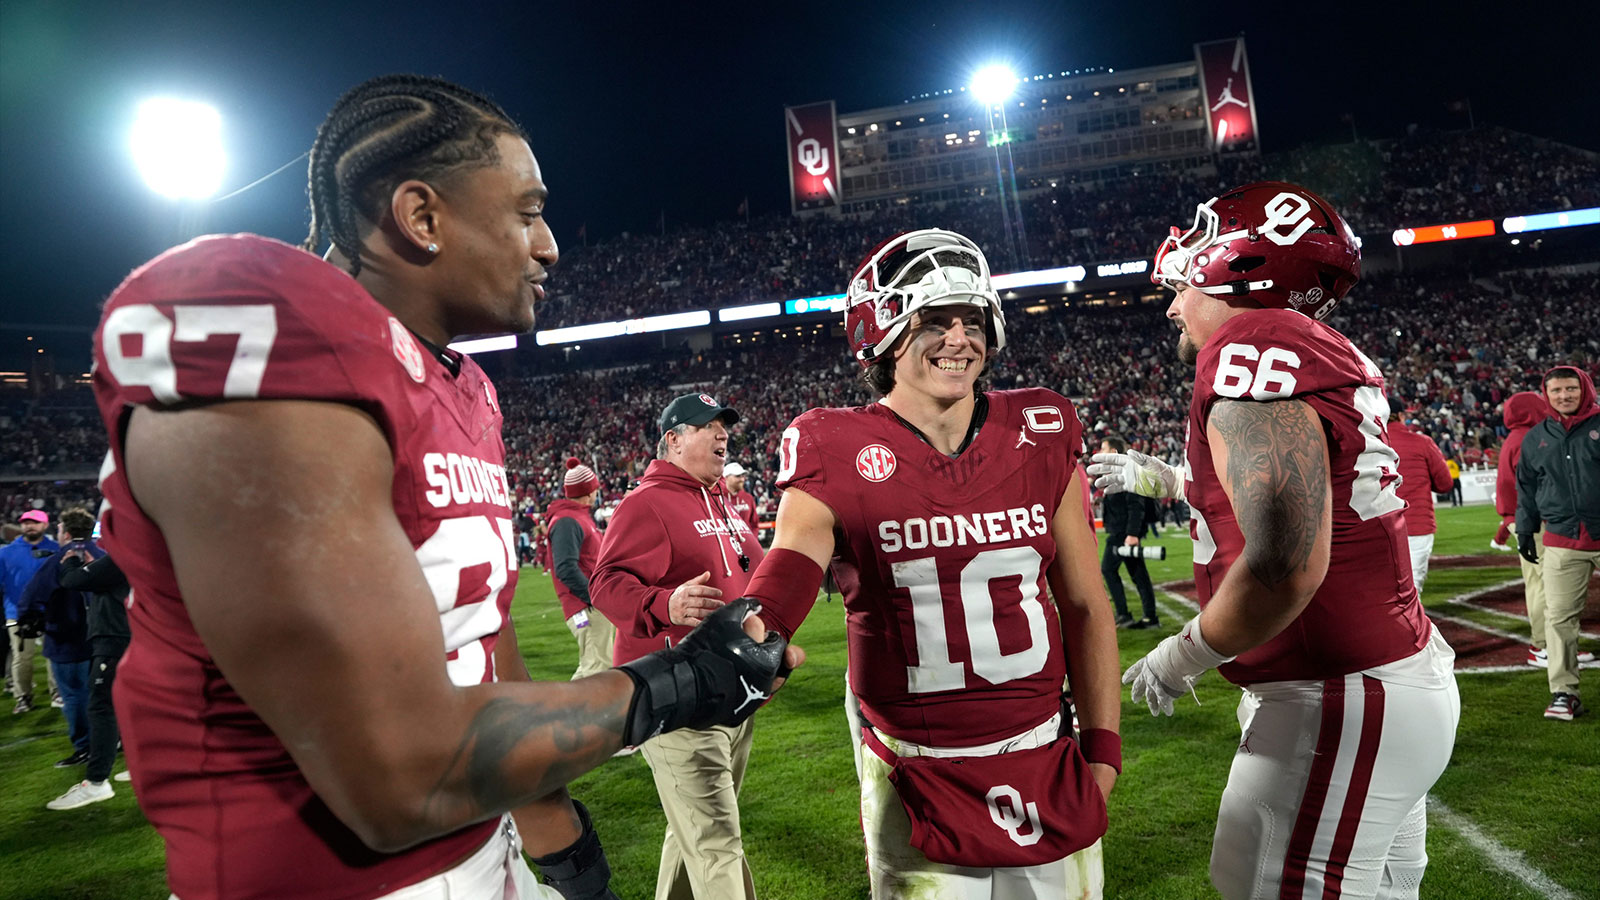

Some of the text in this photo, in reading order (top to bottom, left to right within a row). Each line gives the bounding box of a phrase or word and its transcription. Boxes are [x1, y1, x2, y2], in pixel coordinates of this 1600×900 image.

[798, 138, 830, 176] OU
[1264, 192, 1315, 246] OU
[102, 304, 278, 404] 97
[1212, 343, 1301, 401] 66
[1024, 407, 1063, 432] C
[858, 446, 895, 481] SEC
[878, 503, 1048, 553] SOONERS
[891, 546, 1051, 694] 10
[985, 784, 1044, 847] OU
